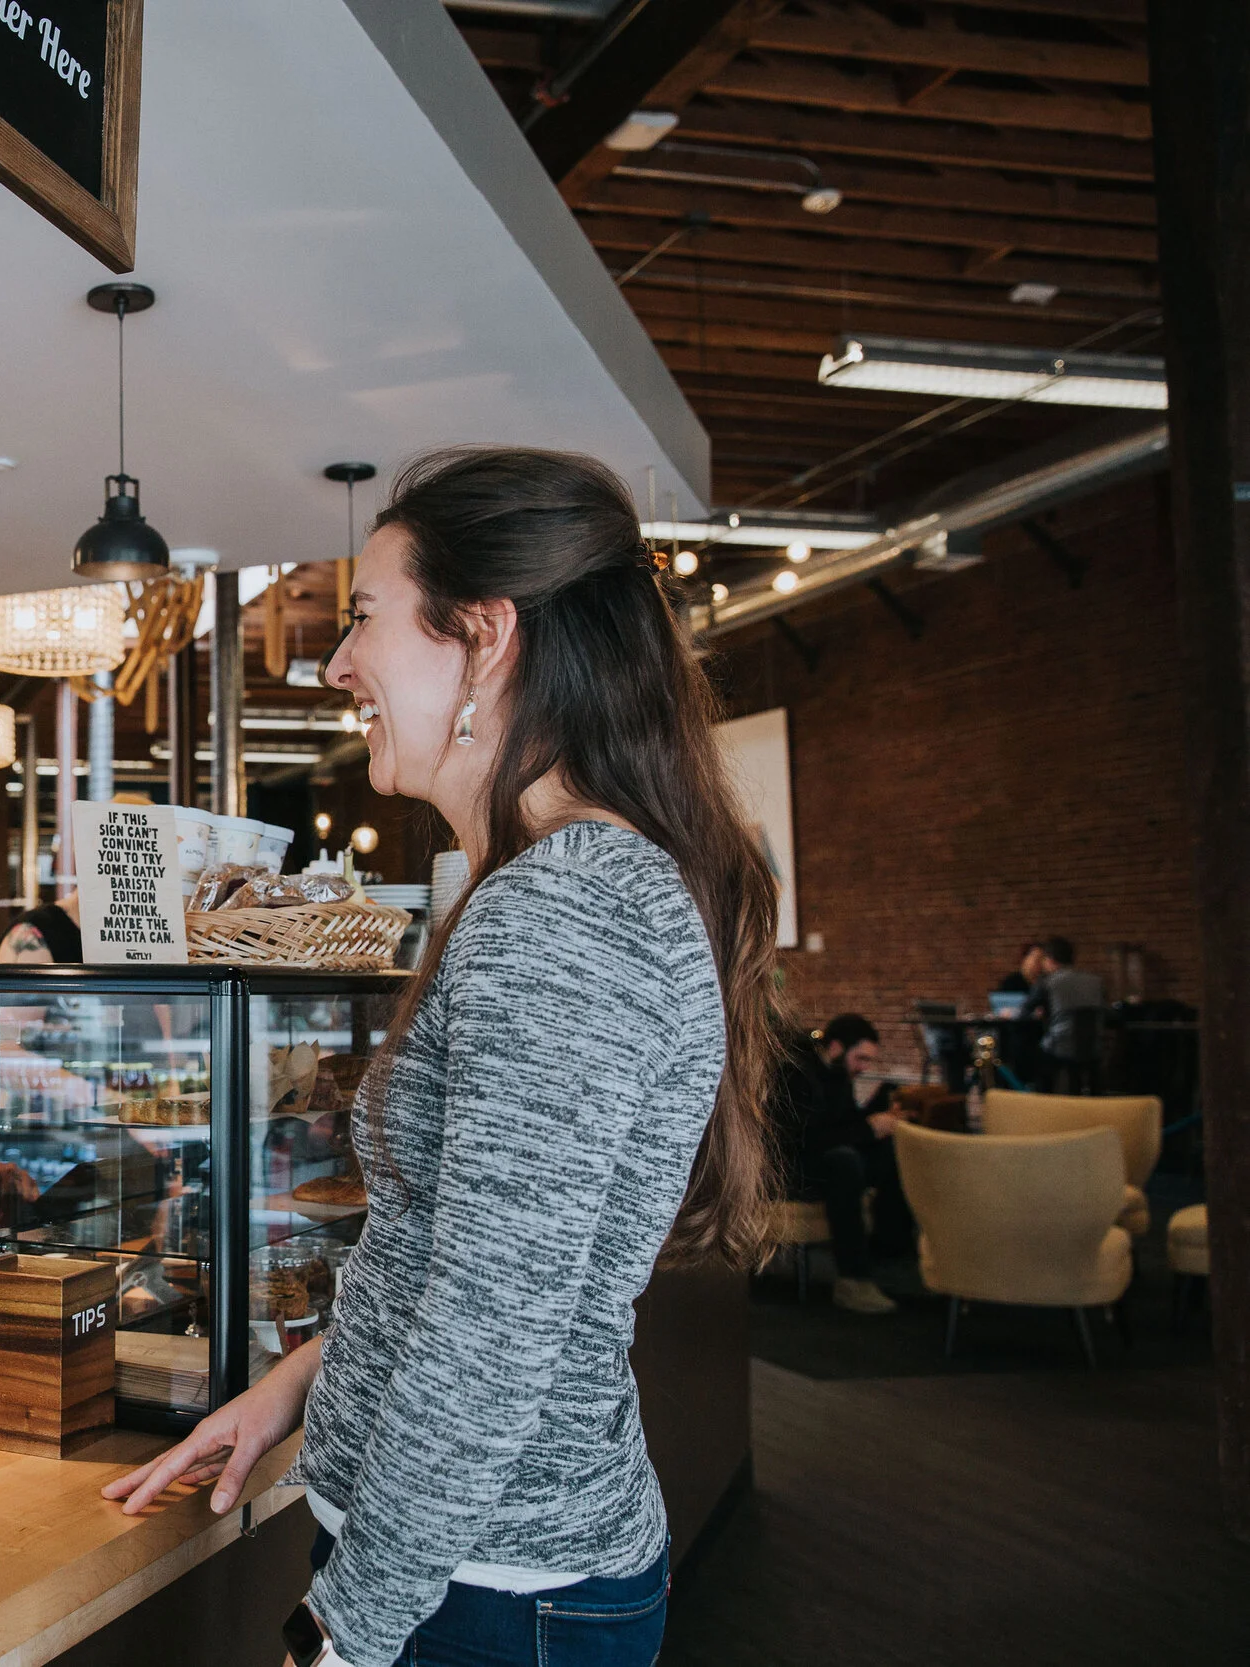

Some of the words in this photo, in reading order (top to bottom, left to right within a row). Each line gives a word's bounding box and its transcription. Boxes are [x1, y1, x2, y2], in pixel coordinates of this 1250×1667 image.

[39, 18, 91, 99] Here
[108, 811, 118, 824] IF
[122, 813, 148, 826] THIS
[99, 824, 124, 837] SIGN
[127, 826, 158, 840] CAN'T
[102, 837, 158, 853] CONVINCE
[98, 849, 121, 862] YOU
[124, 852, 138, 864] TO
[142, 853, 163, 865] TRY
[97, 863, 129, 877] SOME
[132, 865, 166, 879] OATLY
[110, 877, 156, 891] BARISTA
[112, 890, 156, 904] EDITION
[110, 903, 162, 919] OATMILK,
[103, 916, 143, 930] MAYBE
[146, 918, 169, 931] THE
[100, 929, 146, 943] BARISTA
[149, 931, 175, 944] CAN.
[71, 1303, 106, 1337] TIPS
